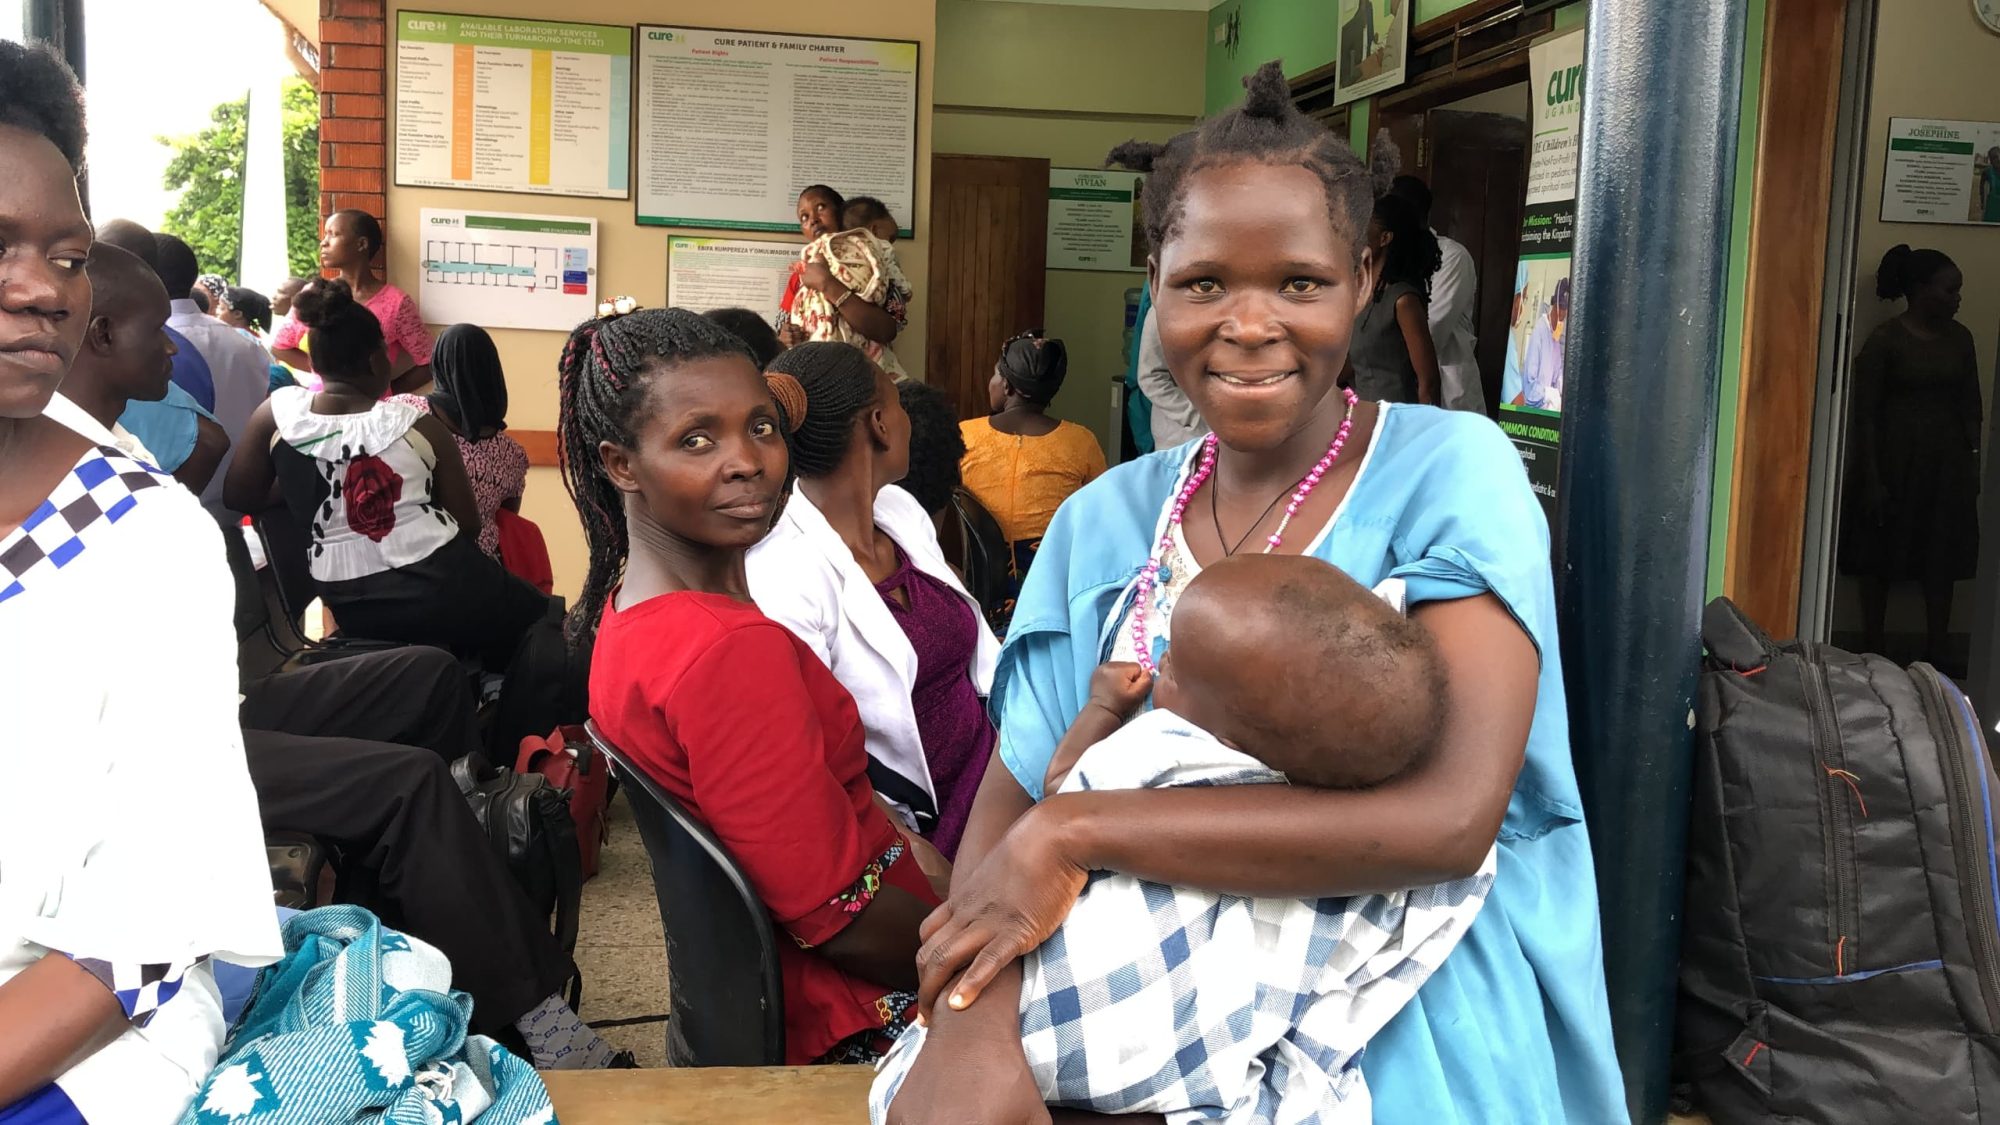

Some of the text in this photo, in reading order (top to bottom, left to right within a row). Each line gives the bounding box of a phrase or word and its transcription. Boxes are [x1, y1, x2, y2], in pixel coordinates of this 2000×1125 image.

[407, 19, 435, 31] cure
[459, 22, 598, 38] AVAILABLE LABORATORY SERVICES
[459, 30, 605, 47] AND THEIR TURNAROUND TIME (TAT)
[647, 31, 674, 42] cure
[714, 38, 845, 53] CURE PATIENT & FAMILY CHARTER
[1908, 127, 1961, 140] JOSEPHINE
[1074, 178, 1107, 188] VIVIAN
[430, 216, 452, 225] cure
[1527, 214, 1552, 227] Mission:
[1542, 228, 1551, 240] the
[1499, 420, 1528, 437] COMMON
